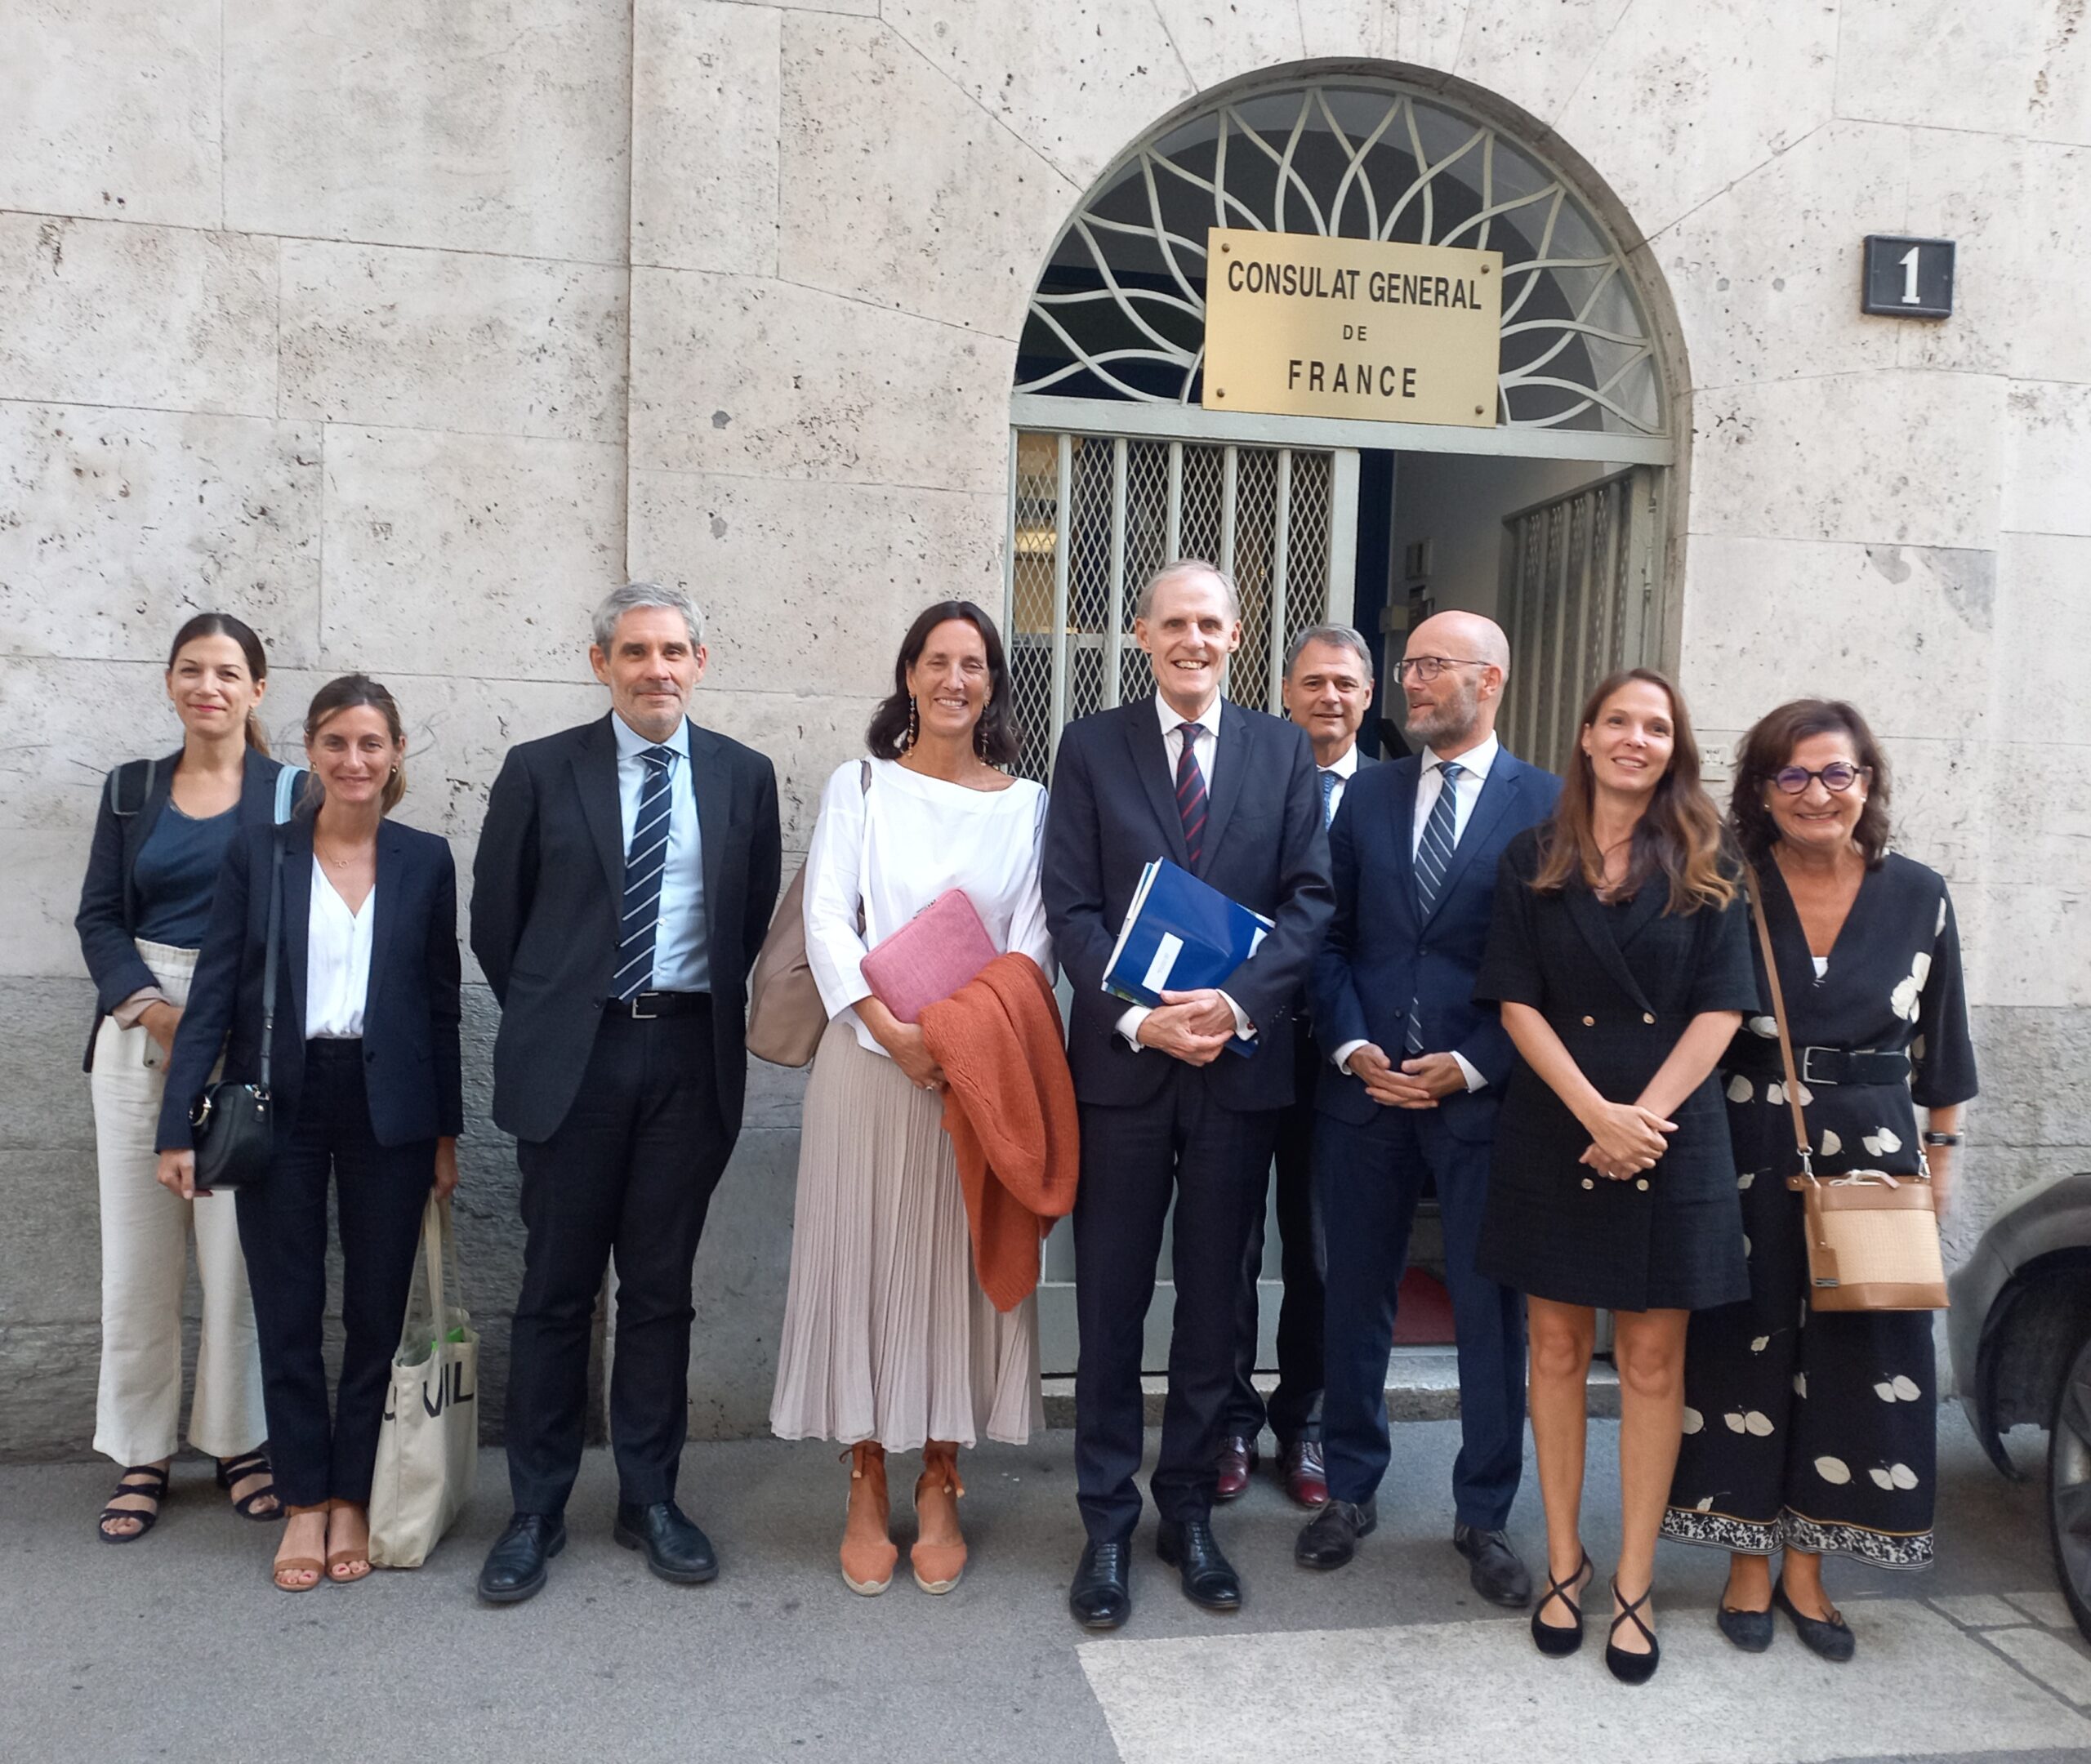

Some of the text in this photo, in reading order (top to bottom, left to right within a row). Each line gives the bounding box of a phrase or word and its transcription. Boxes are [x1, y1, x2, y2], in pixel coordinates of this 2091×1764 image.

[1228, 261, 1482, 310] CONSULAT GENERAL
[1898, 247, 1920, 304] 1
[1343, 325, 1367, 341] DE
[1288, 360, 1416, 398] FRANCE
